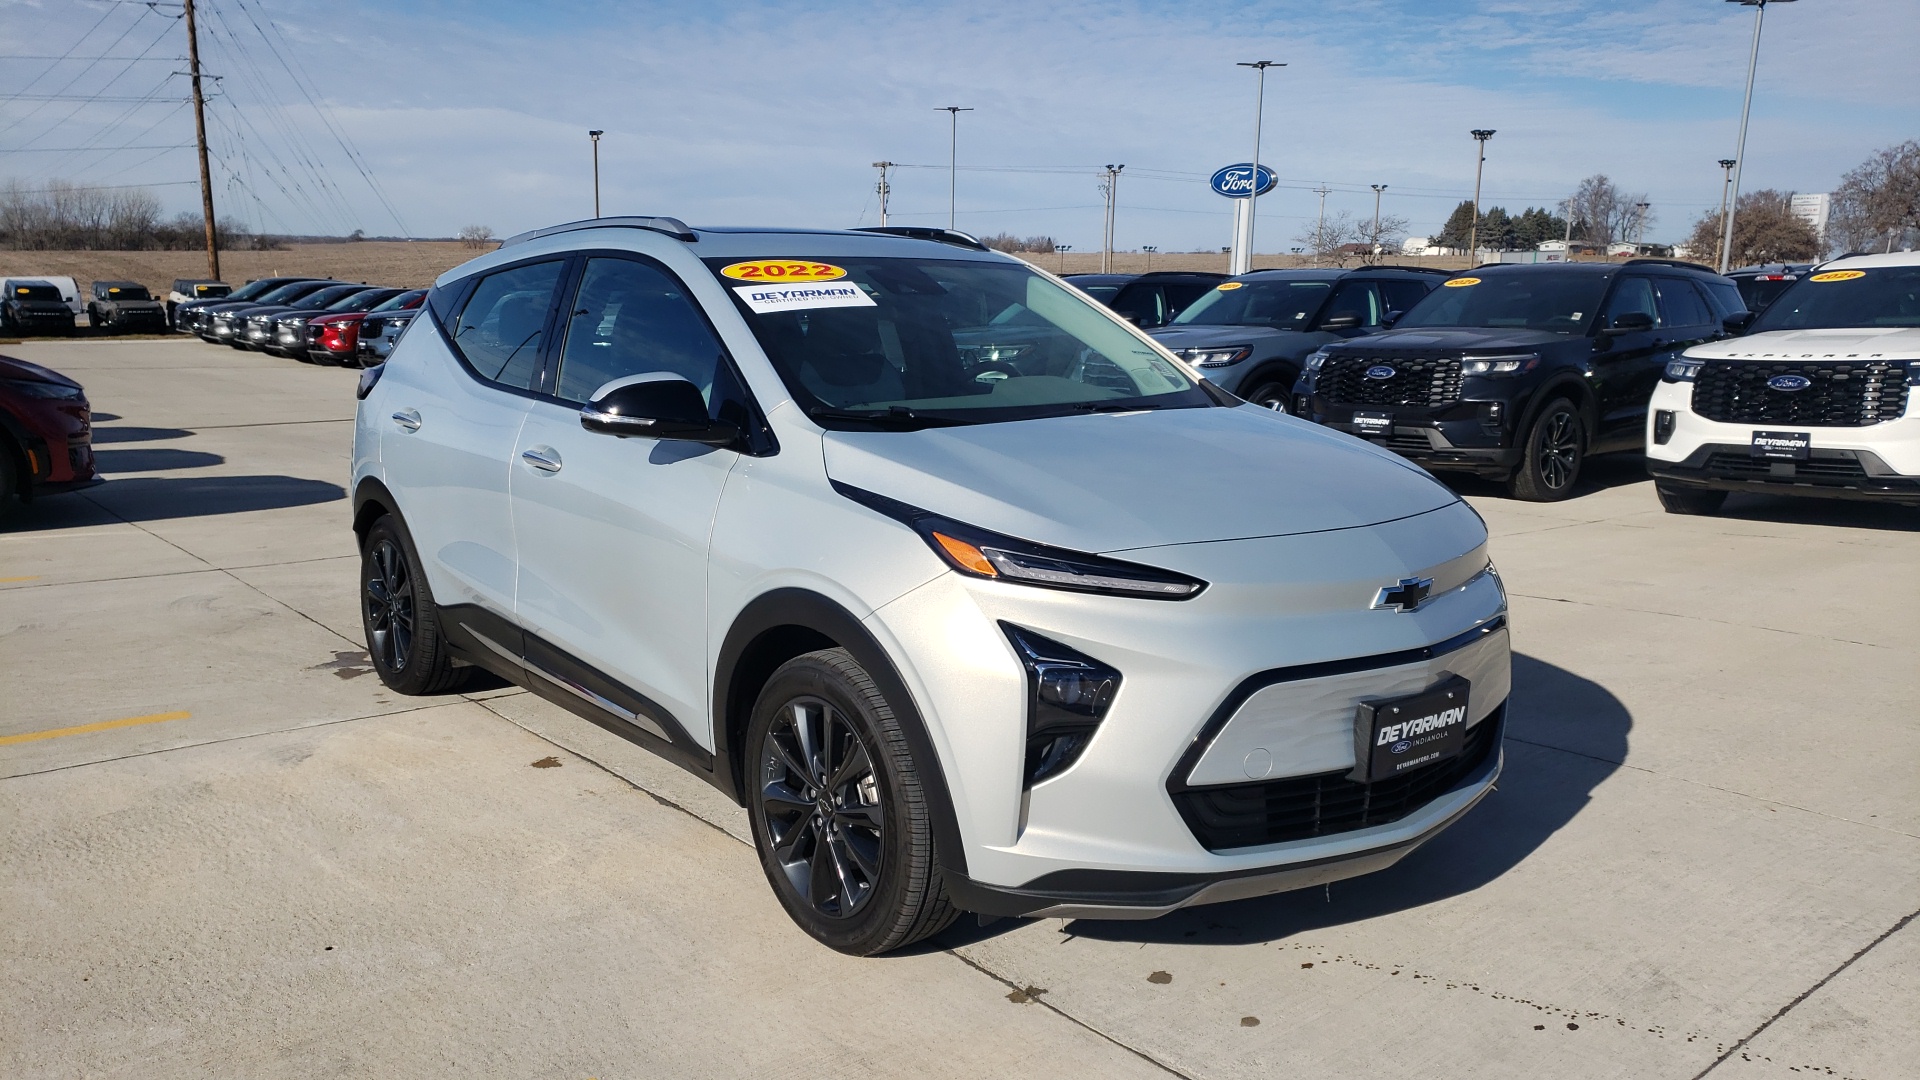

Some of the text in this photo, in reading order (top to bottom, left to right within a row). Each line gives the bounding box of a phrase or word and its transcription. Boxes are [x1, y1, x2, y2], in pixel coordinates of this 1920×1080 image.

[739, 265, 836, 278] 2022
[752, 288, 856, 301] DEYARMAN
[1775, 378, 1801, 388] Ford
[1354, 417, 1390, 425] DEYARMAN
[1754, 437, 1807, 447] DEYARMAN
[1377, 706, 1465, 746] DEYARMAN
[1412, 731, 1448, 746] INDIANOLA
[1396, 751, 1440, 770] DEYARMANFORD.COM
